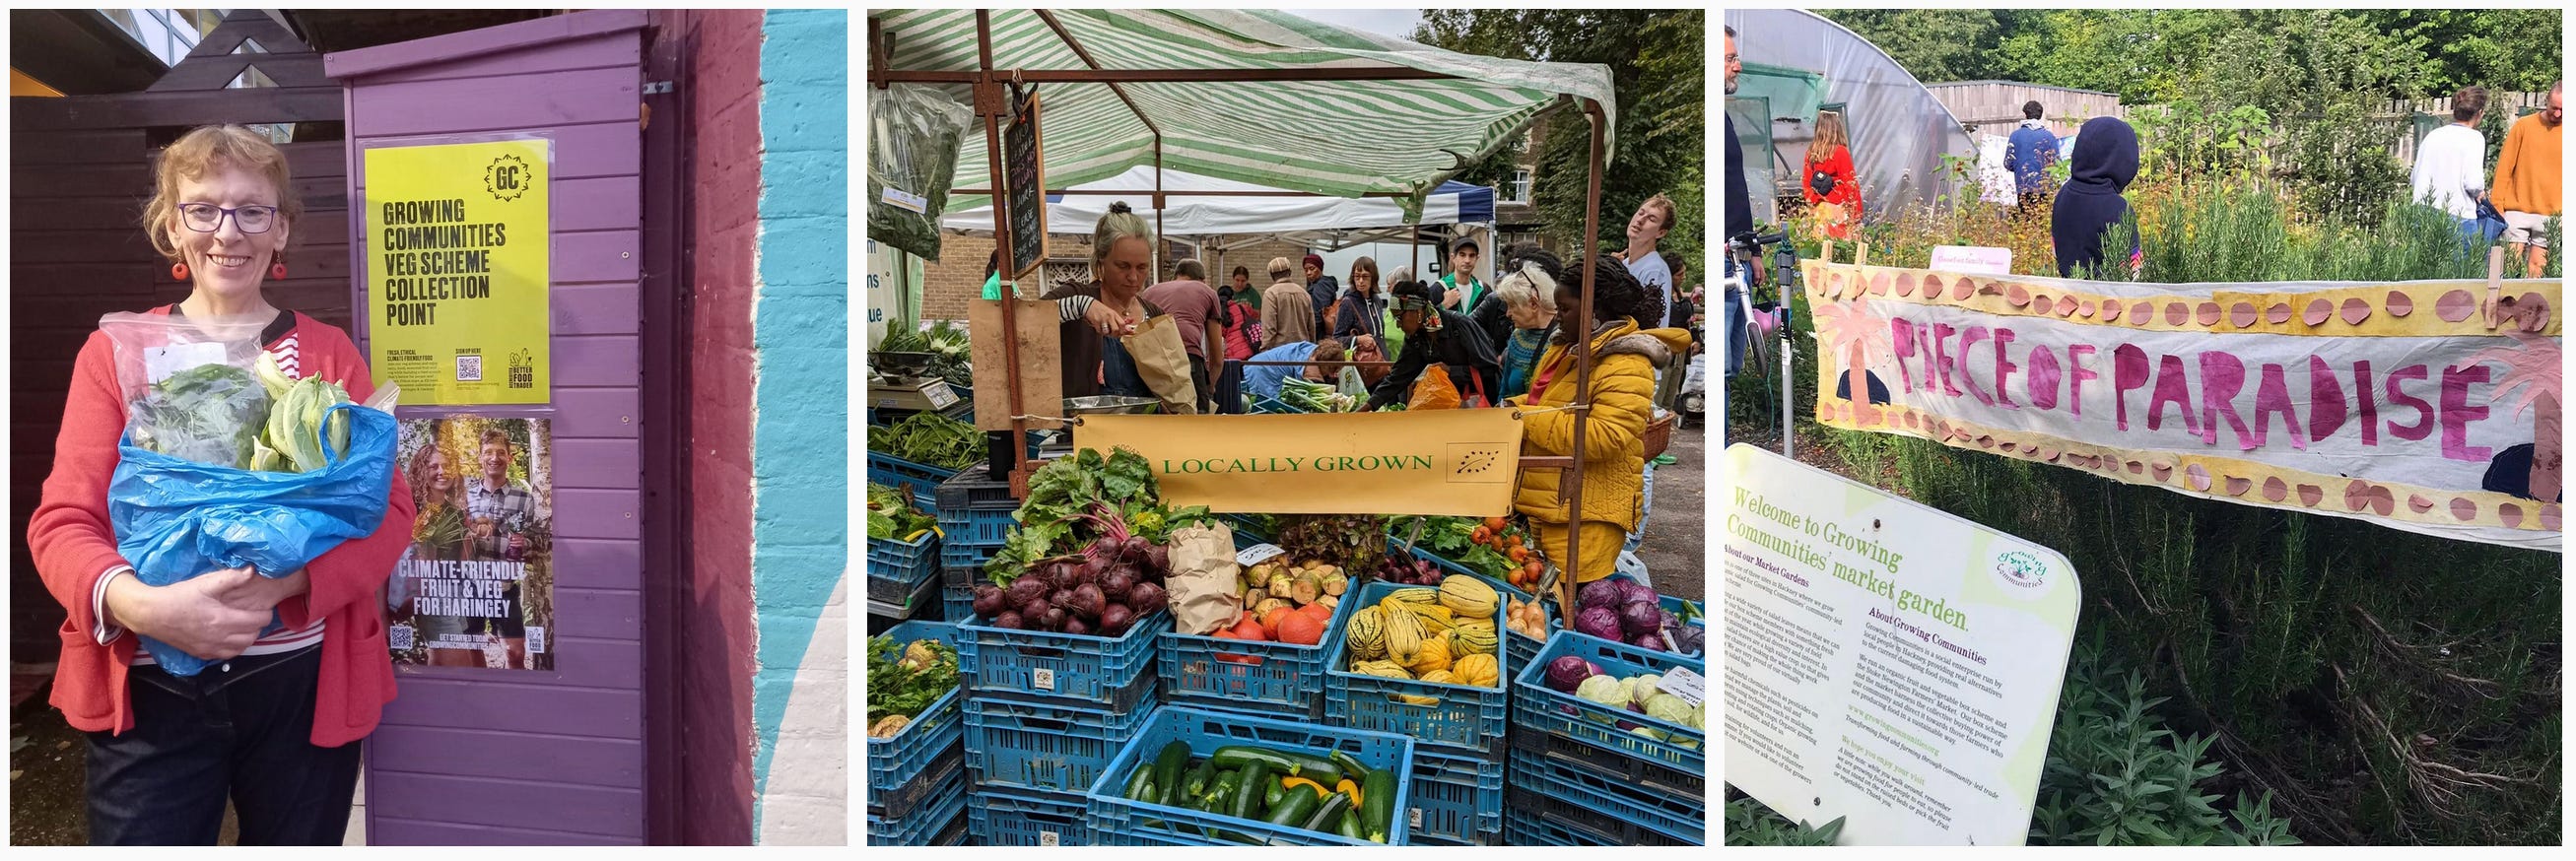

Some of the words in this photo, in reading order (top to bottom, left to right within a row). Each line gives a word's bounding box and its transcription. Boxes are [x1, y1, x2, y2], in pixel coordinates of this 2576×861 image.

[496, 166, 519, 190] GC
[382, 198, 465, 226] GROWING
[383, 223, 507, 251] COMMUNITIES
[384, 252, 418, 277] VEG
[420, 250, 491, 275] SCHEME
[385, 276, 491, 301] COLLECTION
[386, 302, 438, 327] POINT
[513, 373, 532, 382] FOOD
[1890, 316, 2020, 411] PIECE
[2027, 343, 2099, 423] OF
[2114, 342, 2492, 463] PARADISE
[1164, 456, 1306, 474] LOCALLY
[1314, 454, 1435, 472] GROWN
[1734, 486, 1801, 530] Welcome
[1804, 514, 1819, 536] to
[1823, 521, 1903, 573] Growing
[398, 559, 525, 580] CLIMATE-FRIENDLY
[1742, 553, 1753, 563] our
[1755, 557, 1780, 574] Market
[1780, 567, 1809, 587] Gardens
[1998, 551, 2047, 576] growing
[420, 578, 460, 597] FRUIT
[462, 579, 474, 598] &
[475, 580, 503, 599] VEG
[1832, 561, 1895, 600] market
[1897, 585, 1969, 632] garden.
[414, 597, 440, 616] FOR
[442, 597, 510, 618] HARINGEY
[1868, 606, 1893, 625] About
[1892, 616, 1931, 642] Growing
[1931, 632, 1987, 665] Communities
